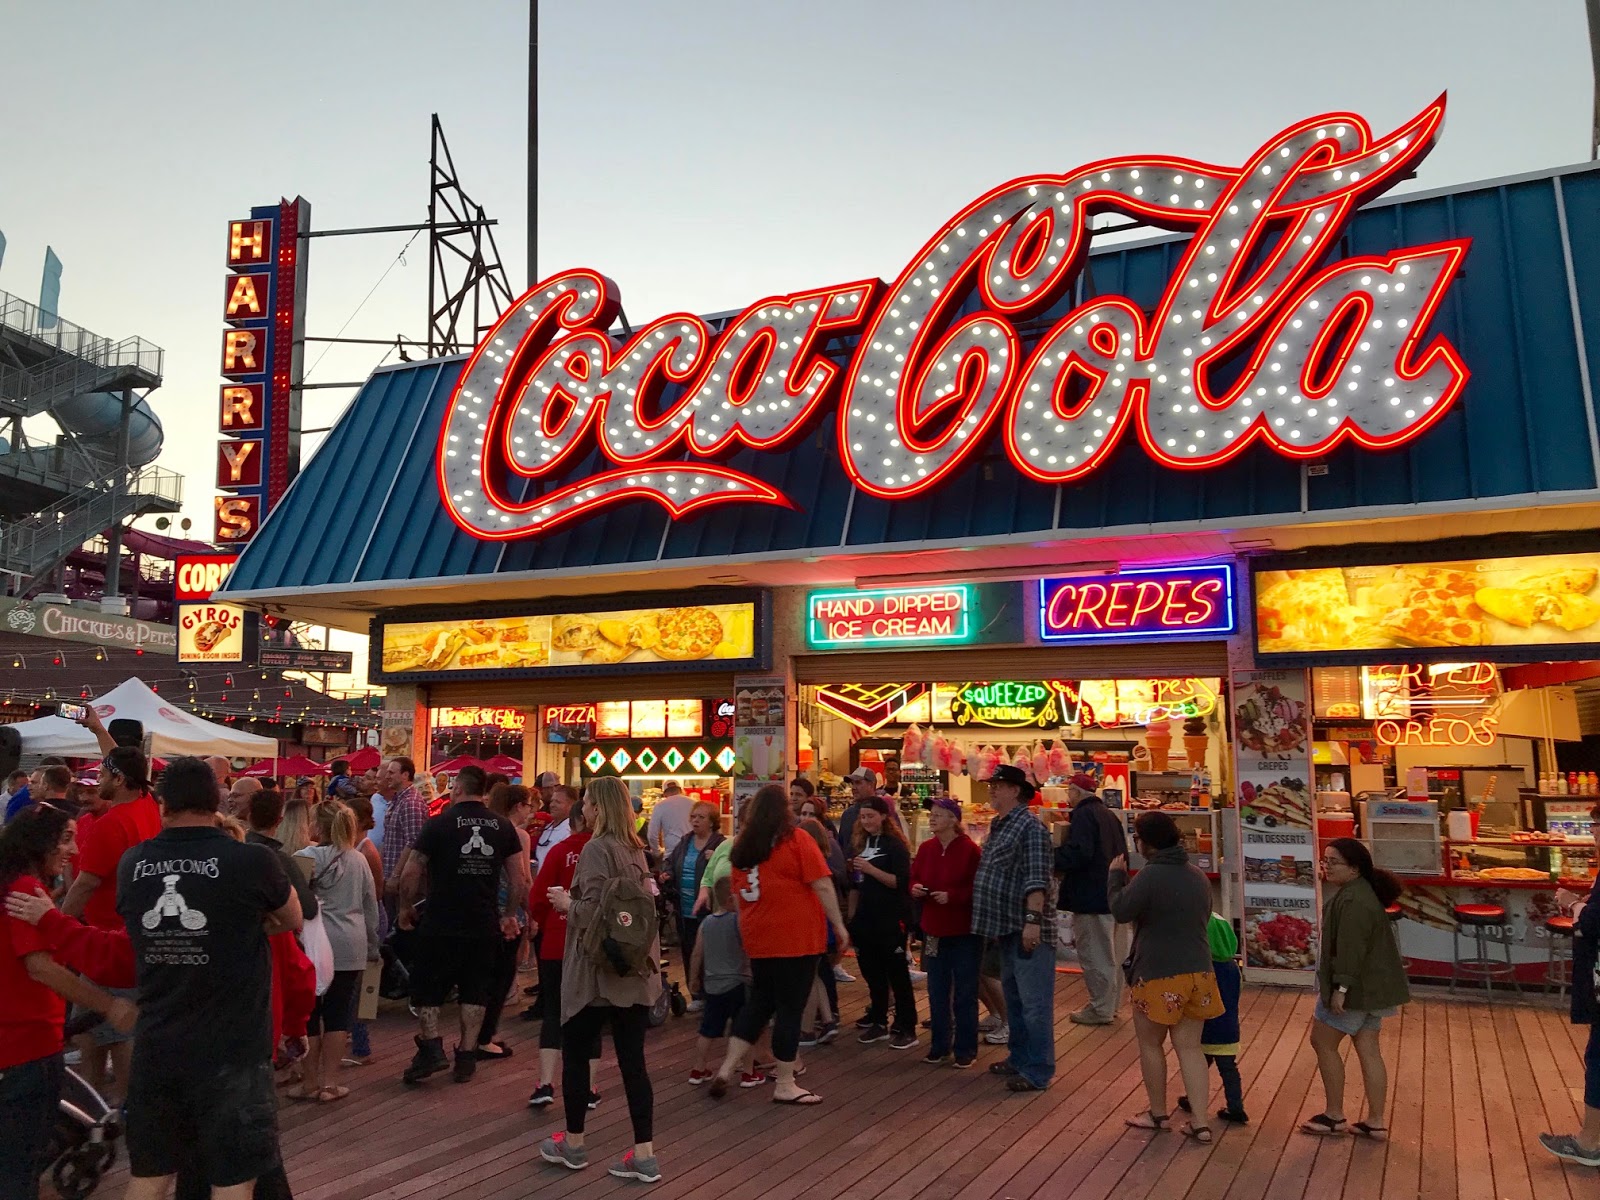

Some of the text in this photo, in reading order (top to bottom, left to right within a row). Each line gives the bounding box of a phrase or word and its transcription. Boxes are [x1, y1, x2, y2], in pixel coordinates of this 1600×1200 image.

[817, 593, 961, 618] HAND DIPPED
[1048, 579, 1222, 629] CREPES
[182, 607, 241, 629] GYROS
[829, 617, 951, 640] ICE CREAM
[1250, 672, 1286, 681] WAFFLES
[964, 682, 1046, 706] SQUEEZED
[545, 706, 597, 724] PIZZA
[978, 707, 1036, 720] LEMONADE
[1377, 718, 1498, 746] OREOS
[1257, 761, 1289, 770] CREPES
[1247, 834, 1306, 844] FUN DESSERTS
[1251, 898, 1310, 909] FUNNEL CAKES
